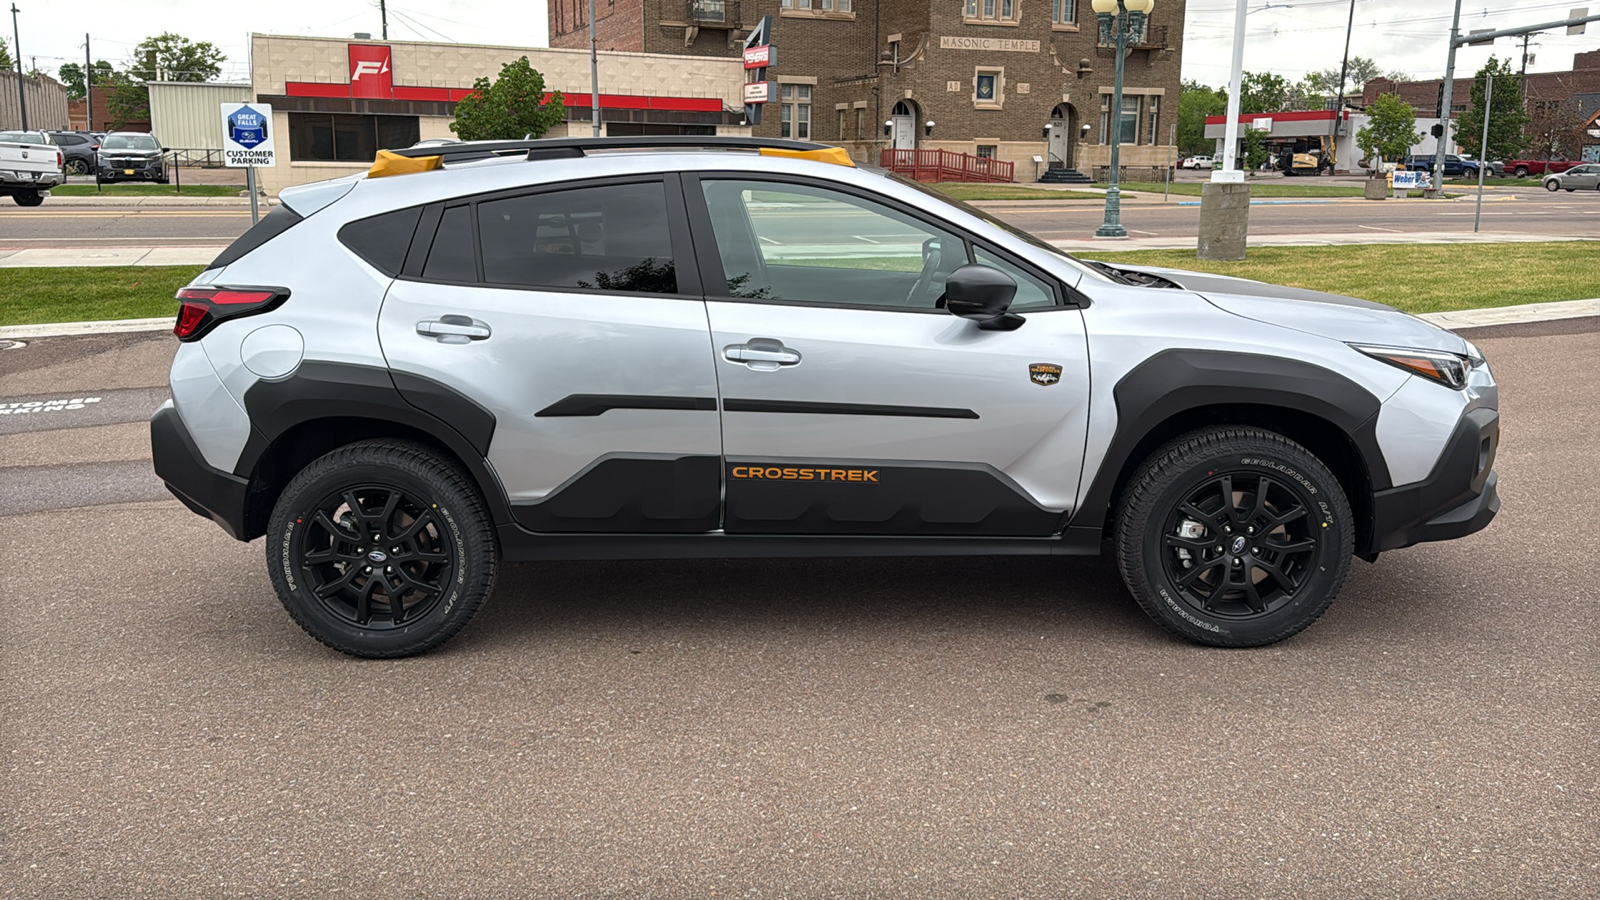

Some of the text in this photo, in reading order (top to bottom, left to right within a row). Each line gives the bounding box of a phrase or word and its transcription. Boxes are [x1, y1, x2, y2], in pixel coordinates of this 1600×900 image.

[942, 37, 1039, 51] MASONIC TEMPLE
[1394, 173, 1414, 182] Weber
[732, 466, 879, 482] CROSSTREK
[1240, 458, 1334, 524] GEOLANDAR A/T
[282, 521, 298, 592] YOKOHAMA
[440, 507, 466, 615] GEOLANDAR A/T
[1159, 588, 1220, 633] YOKOHAMA
